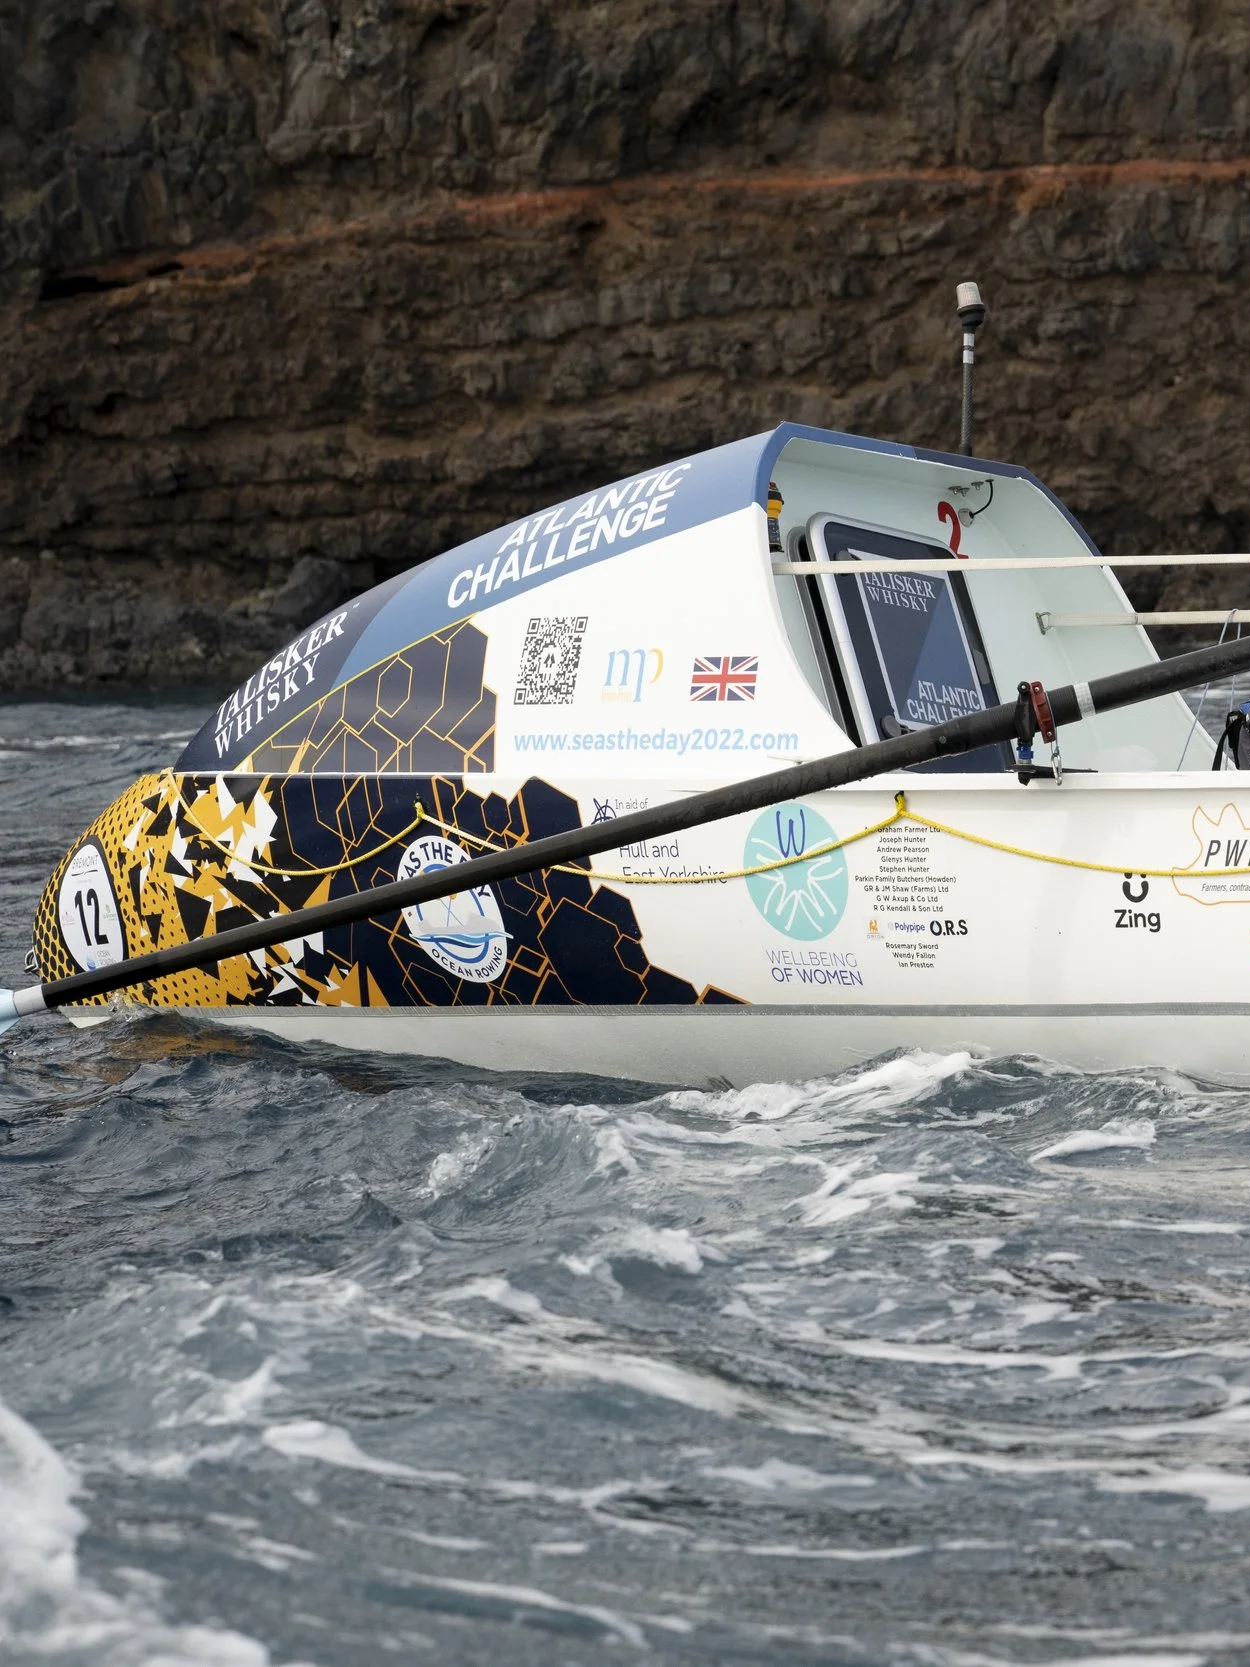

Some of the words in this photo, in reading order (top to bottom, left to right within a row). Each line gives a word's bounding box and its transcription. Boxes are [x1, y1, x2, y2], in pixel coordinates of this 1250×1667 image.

[497, 463, 691, 555] ATLANTIC
[447, 490, 676, 608] CHALLENGE
[864, 572, 936, 599] TALISKER
[866, 586, 929, 612] WHISKY
[215, 611, 348, 734] TALISKER
[918, 680, 980, 710] ATLANTIC
[214, 652, 320, 758] WHISKY
[907, 699, 974, 724] CHALLE
[514, 728, 799, 756] www.seastheday2022.com
[615, 800, 625, 809] In
[625, 799, 638, 810] aid
[639, 798, 649, 810] of
[652, 839, 680, 858] and
[879, 836, 902, 844] Joseph
[401, 851, 421, 881] AS
[420, 841, 453, 865] THE
[881, 856, 903, 864] Glenys
[1204, 839, 1221, 867] P
[1225, 839, 1248, 867] W
[875, 875, 895, 883] Family
[897, 875, 924, 883] Butchers
[925, 876, 956, 884] (Howden)
[879, 866, 905, 874] Stephen
[911, 885, 936, 893] (Farms)
[1201, 883, 1228, 892] Farmers,
[892, 895, 909, 903] Axup
[74, 888, 109, 946] 12
[1114, 909, 1161, 933] Zing
[894, 922, 926, 933] Polypipe
[930, 919, 968, 936] O.R.S
[885, 942, 917, 950] Rosemary
[431, 948, 474, 978] OCEAN
[475, 946, 503, 979] ROWING
[766, 949, 857, 968] WELLBEING
[892, 952, 914, 960] Wendy
[771, 967, 793, 983] OF
[796, 968, 863, 986] WOMEN
